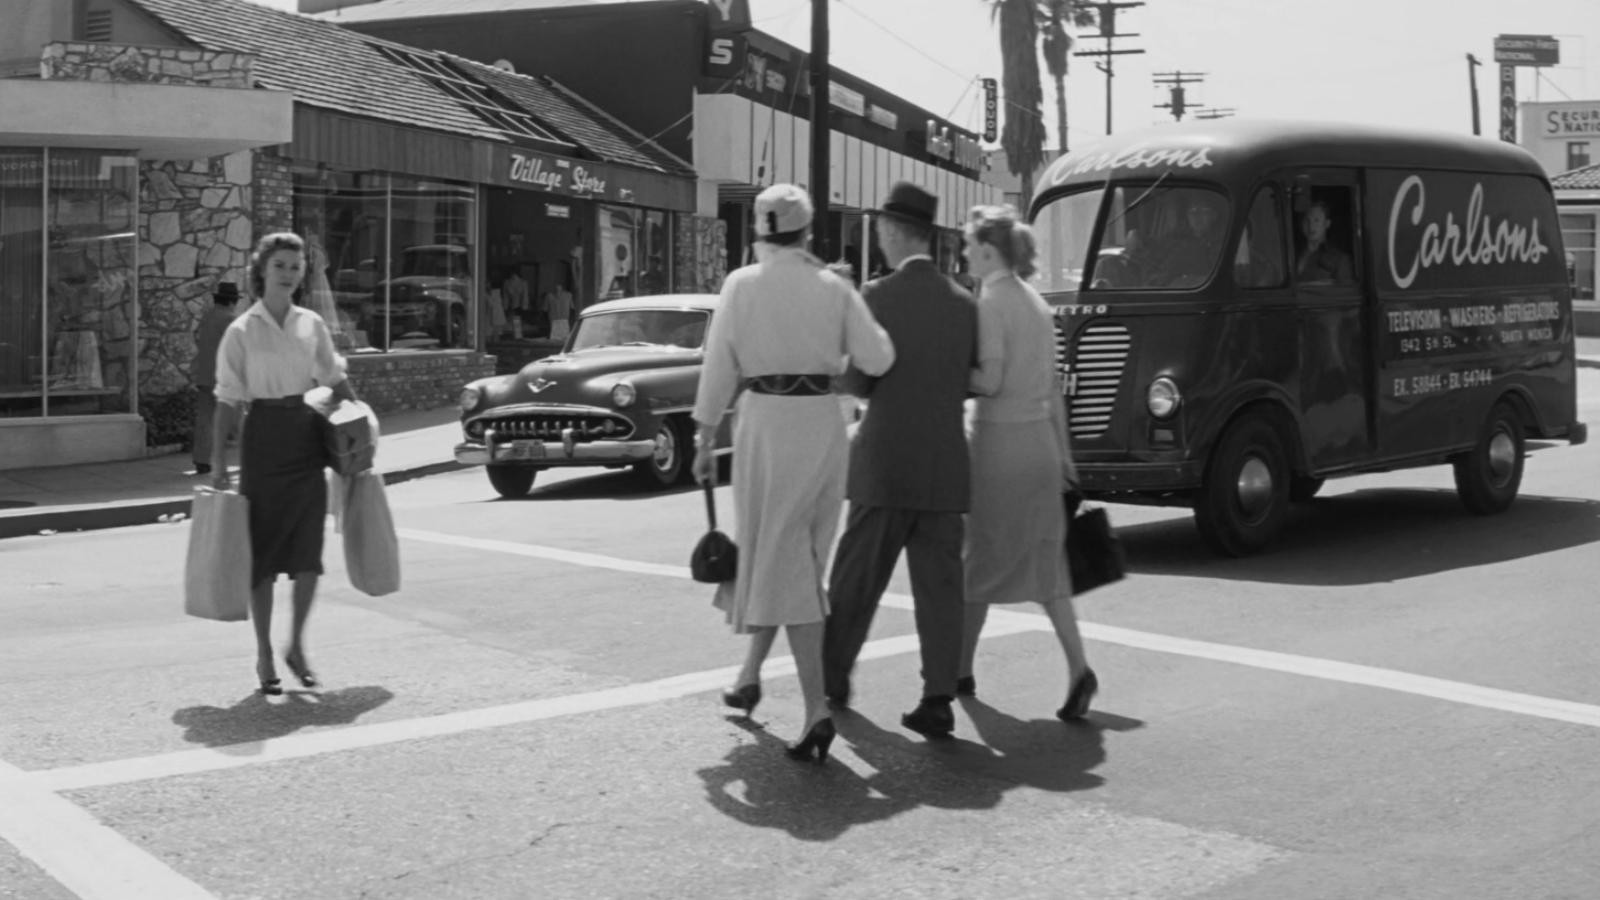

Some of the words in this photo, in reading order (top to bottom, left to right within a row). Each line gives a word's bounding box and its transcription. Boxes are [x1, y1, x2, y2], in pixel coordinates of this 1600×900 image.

[1503, 66, 1514, 139] BANK
[509, 154, 562, 191] Village
[570, 166, 606, 193] Store
[1052, 145, 1213, 185] Carlsons
[1388, 174, 1548, 289] Carlsons
[1387, 308, 1441, 332] TELEVISION
[1449, 305, 1496, 327] WASHERS
[1503, 301, 1559, 323] REFRIGERATORS
